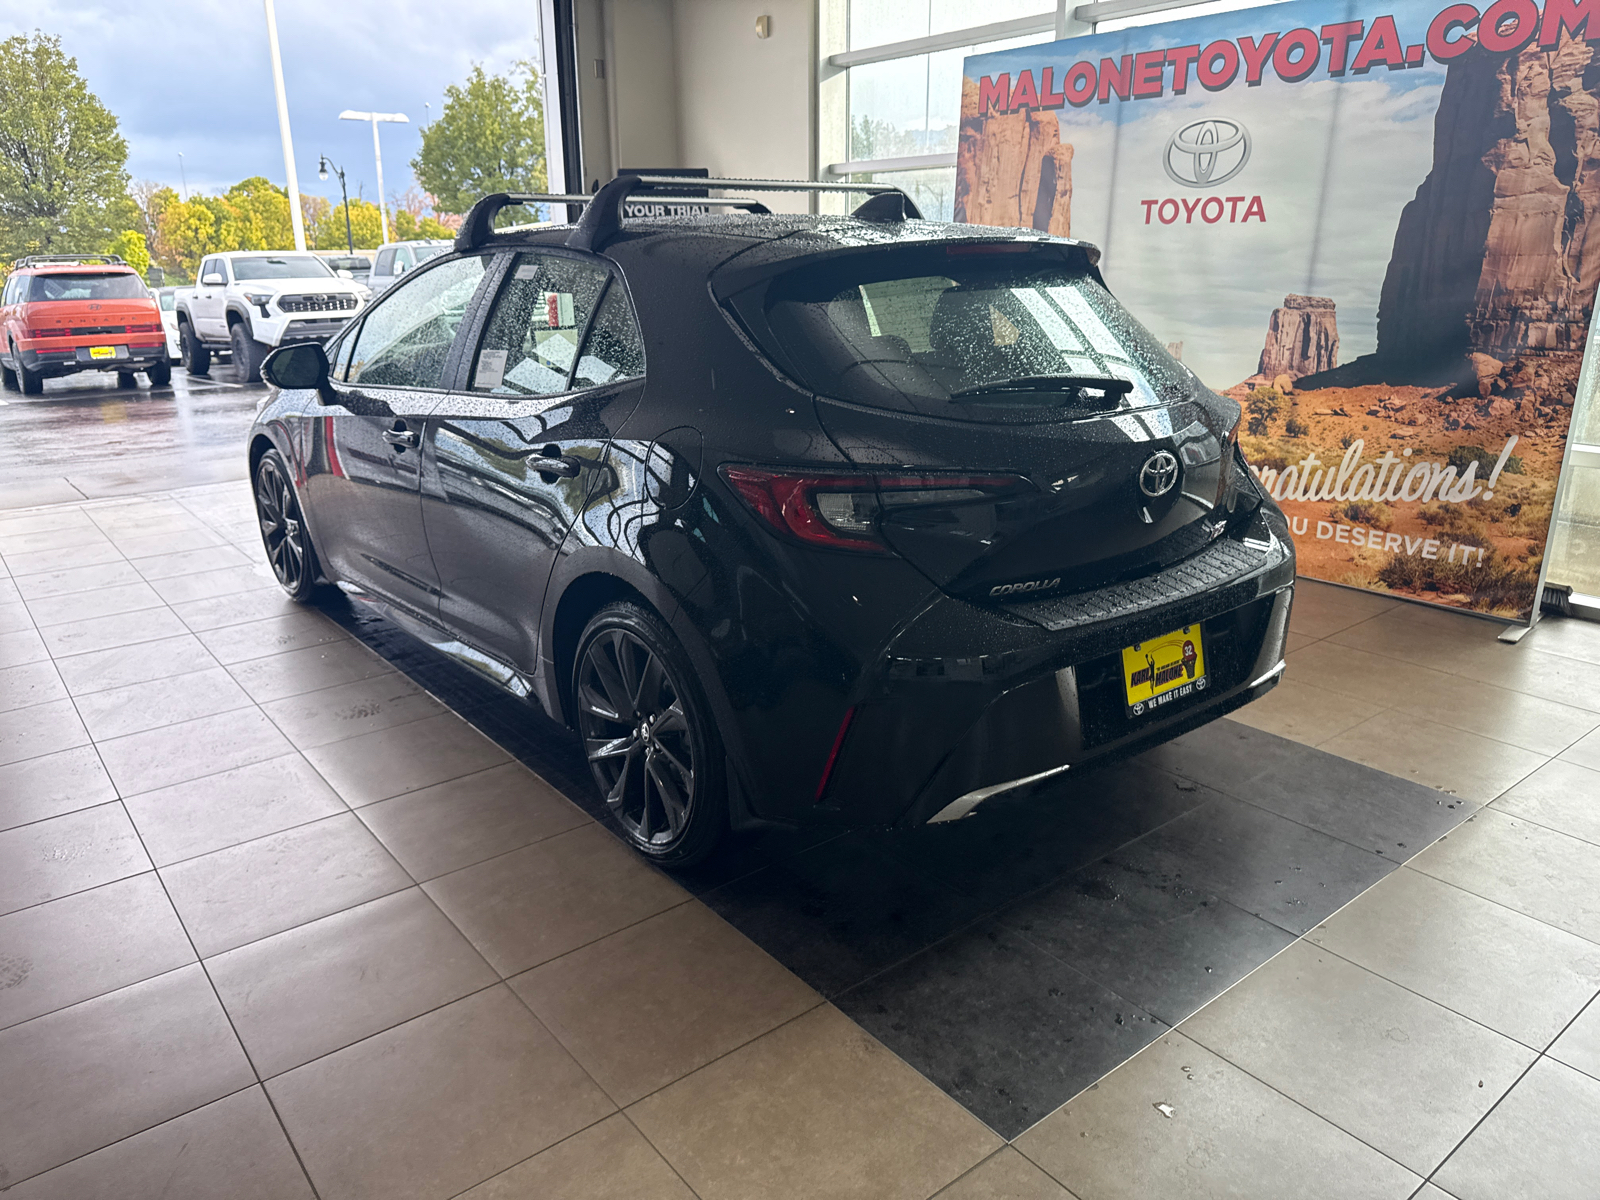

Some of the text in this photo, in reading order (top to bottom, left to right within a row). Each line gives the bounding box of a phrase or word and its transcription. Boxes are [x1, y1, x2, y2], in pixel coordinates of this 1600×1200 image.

[977, 0, 1600, 115] MALONETOYOTA.COM
[625, 205, 665, 217] YOUR
[1141, 195, 1267, 225] TOYOTA
[1316, 520, 1441, 560] DESERVE
[1448, 544, 1485, 568] IT!
[989, 578, 1061, 596] COROLLA
[1184, 645, 1193, 656] 32
[1131, 667, 1151, 688] KARL
[1148, 684, 1193, 709] WE MAKE IT EASY
